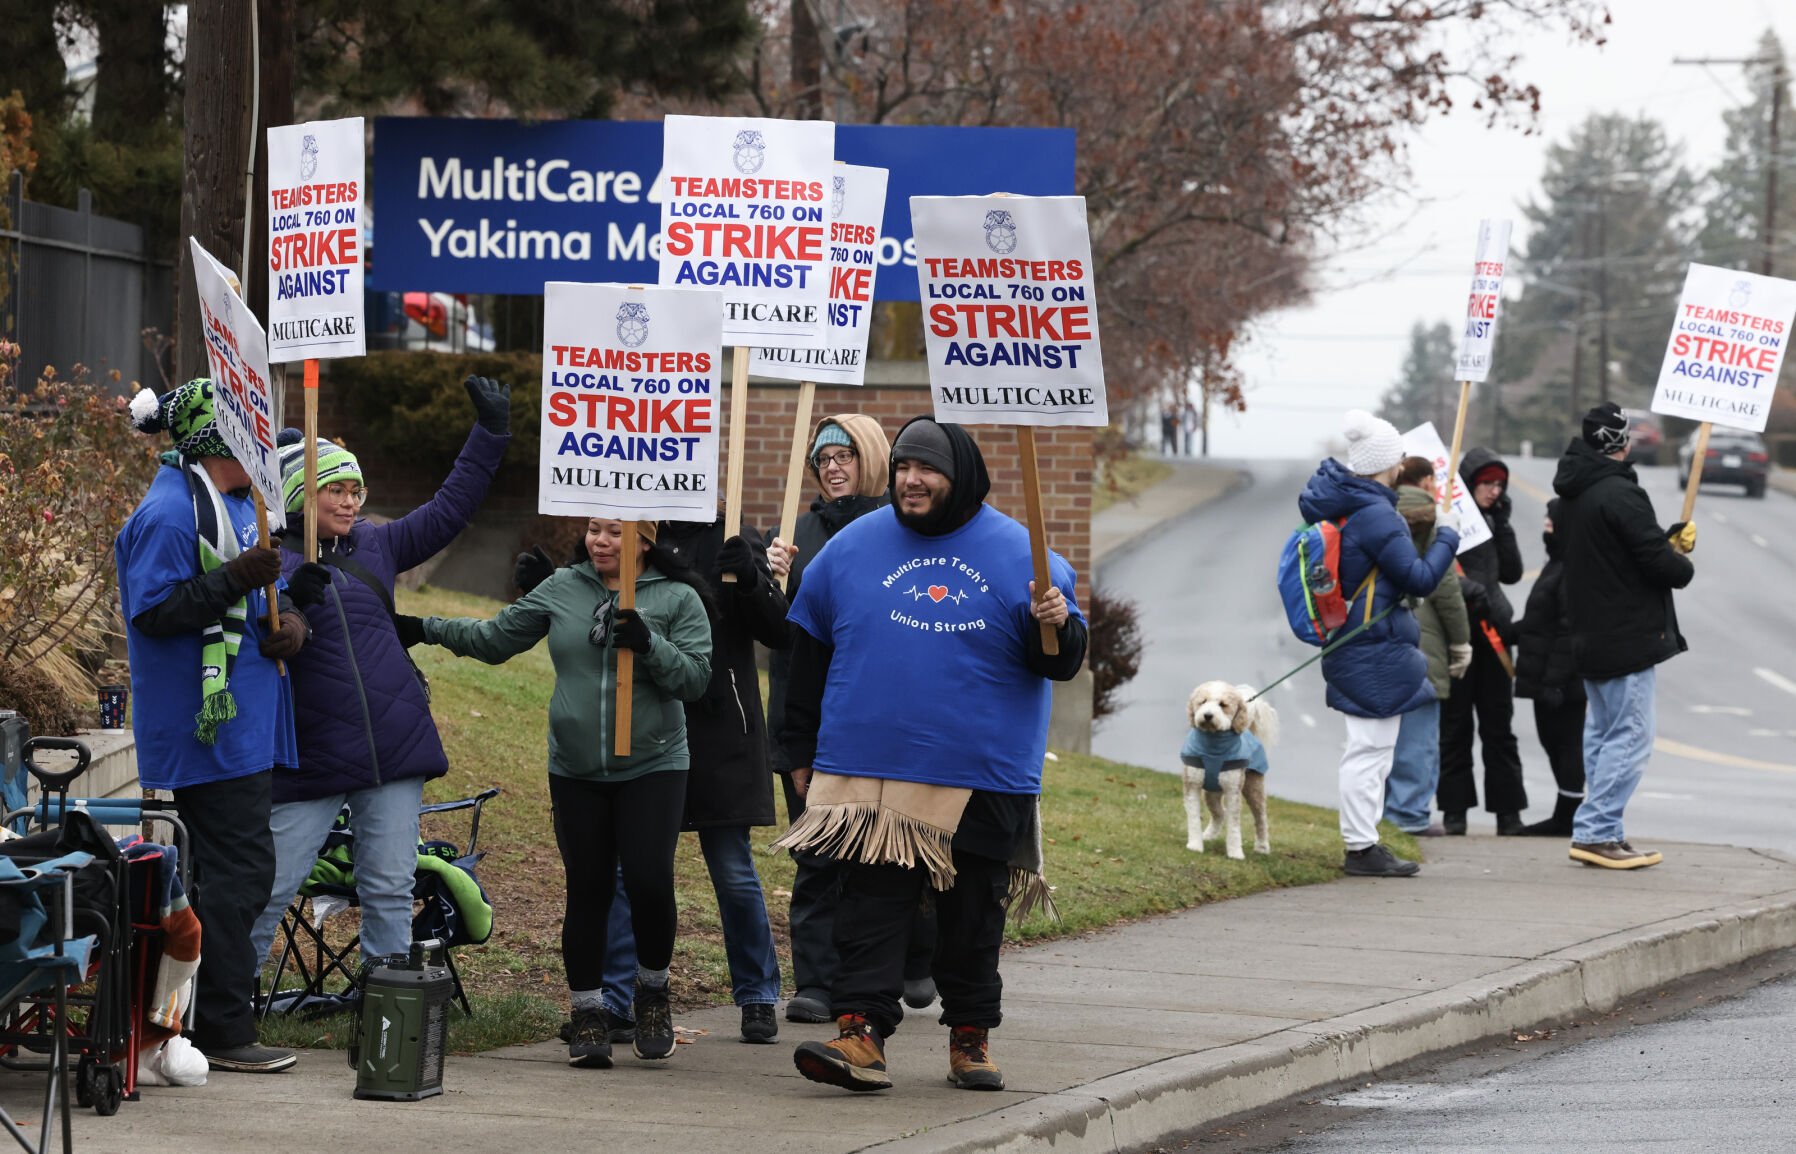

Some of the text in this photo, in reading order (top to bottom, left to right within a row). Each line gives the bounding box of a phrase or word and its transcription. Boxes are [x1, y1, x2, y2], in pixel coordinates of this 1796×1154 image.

[418, 156, 642, 204] MultiCare
[671, 176, 823, 202] TEAMSTERS
[272, 181, 358, 210] TEAMSTERS
[273, 207, 356, 232] LOCAL 760 ON
[670, 202, 823, 222] LOCAL 760 ON
[418, 218, 591, 260] Yakima
[666, 221, 824, 261] STRIKE
[831, 222, 875, 246] STERS
[270, 228, 358, 272] STRIKE
[830, 247, 849, 262] 760
[853, 249, 874, 265] ON
[675, 260, 812, 289] AGAINST
[925, 258, 1084, 281] TEAMSTERS
[277, 269, 350, 300] AGAINST
[829, 266, 873, 302] IKE
[928, 283, 1085, 302] LOCAL 760 ON
[725, 302, 818, 324] TICARE
[1468, 293, 1497, 319] RIKE
[1685, 304, 1784, 334] TEAMSTERS
[272, 316, 356, 342] MULTICARE
[929, 303, 1092, 341] STRIKE
[1679, 320, 1781, 348] LOCAL 760 ON
[201, 296, 267, 397] TEAMSERS
[552, 345, 711, 373] TEAMSTERS
[758, 347, 861, 366] MULTICARE
[944, 341, 1082, 370] AGAINST
[1672, 333, 1778, 373] STRIKE
[552, 372, 710, 394] LOCAL 760 ON
[1672, 359, 1765, 389] AGAINST
[249, 389, 269, 416] ON
[941, 386, 1094, 406] MULTICARE
[1664, 388, 1761, 417] MULTICARE
[548, 391, 712, 434] STRIKE
[557, 431, 700, 462] AGAINST
[551, 466, 707, 492] MULTICARE
[882, 556, 989, 593] MultiCare Tech's
[890, 609, 986, 632] Union Strong
